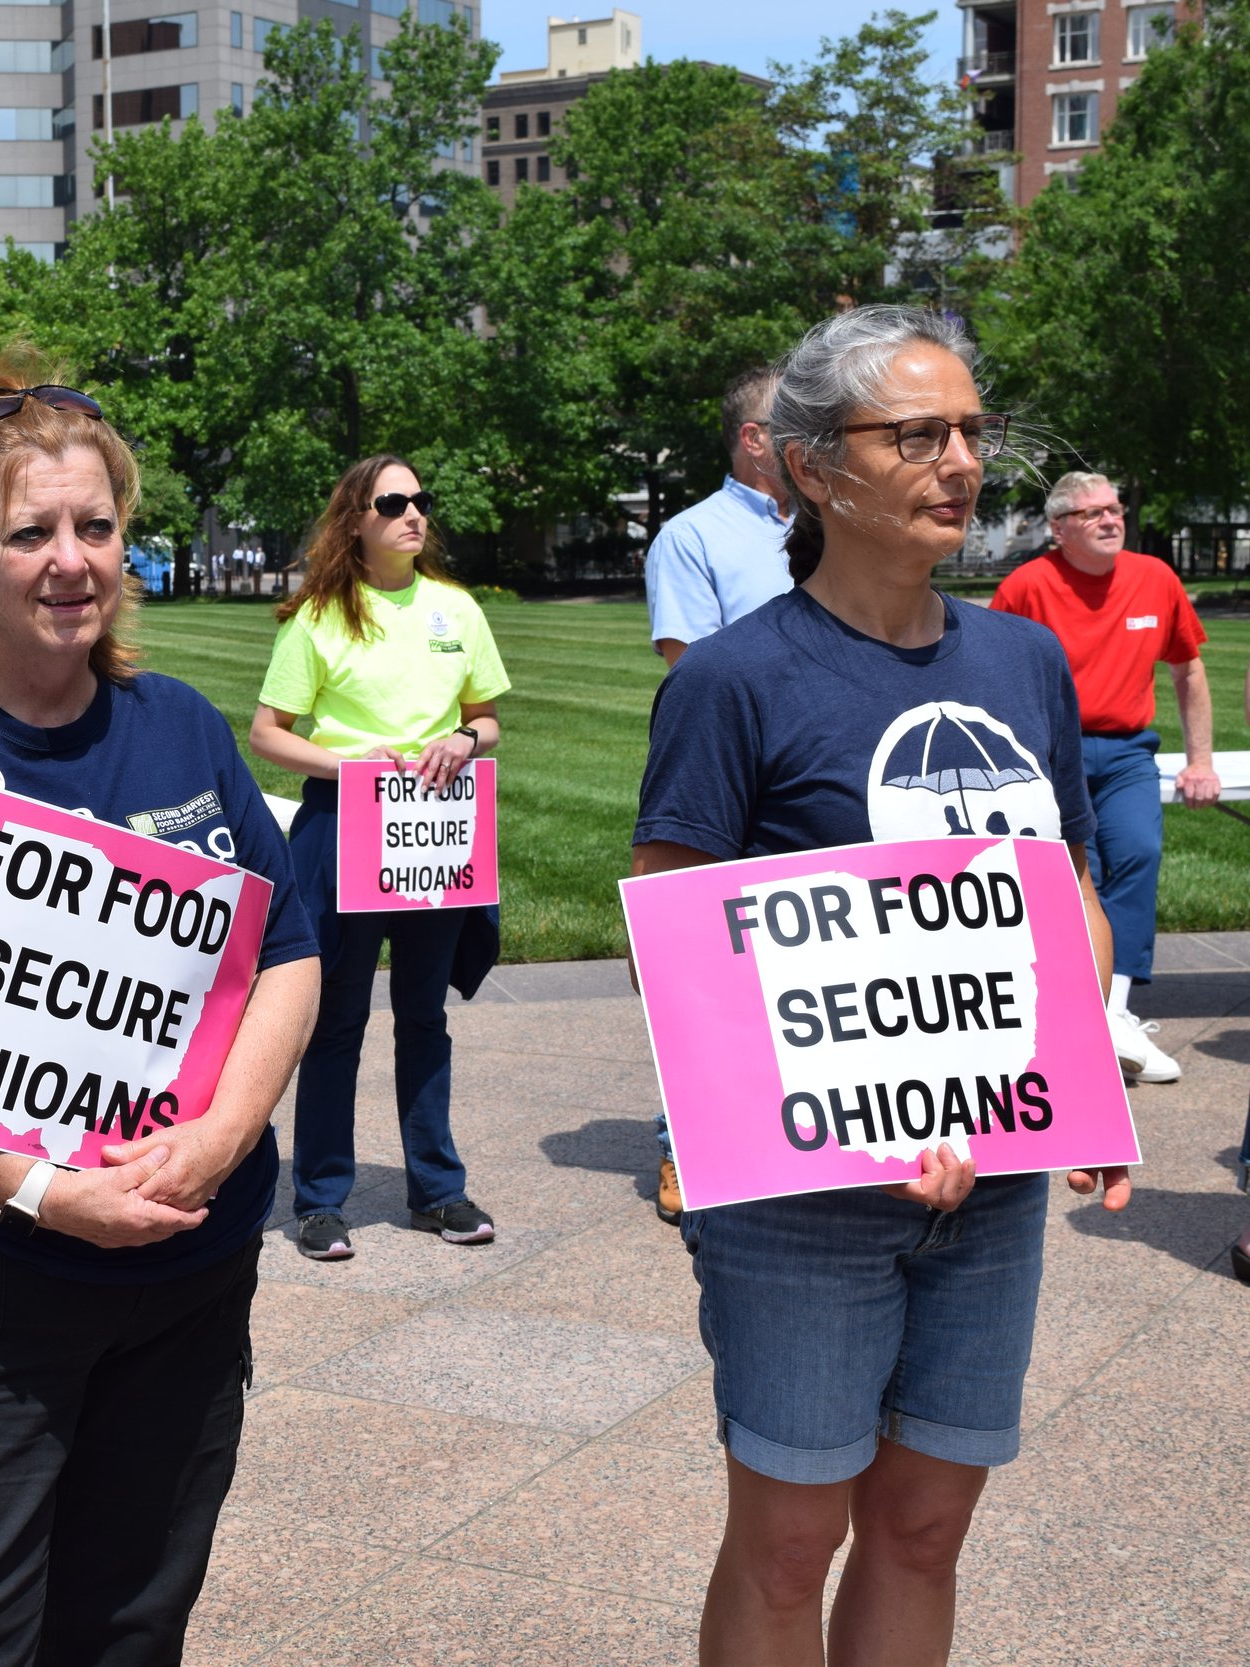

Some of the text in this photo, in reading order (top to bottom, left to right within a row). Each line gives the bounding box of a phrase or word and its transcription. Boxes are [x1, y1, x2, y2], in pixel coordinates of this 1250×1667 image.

[375, 776, 417, 803] FOR
[151, 809, 182, 822] SECOND
[180, 793, 215, 816] HARVEST
[155, 812, 196, 829] FOOD BANK
[386, 819, 468, 848] SECURE
[378, 863, 474, 894] OHIOANS
[98, 865, 233, 956] FOOD
[722, 871, 1024, 955] FOR FOOD
[776, 970, 1023, 1048] SECURE
[780, 1071, 1054, 1152] OHIOANS
